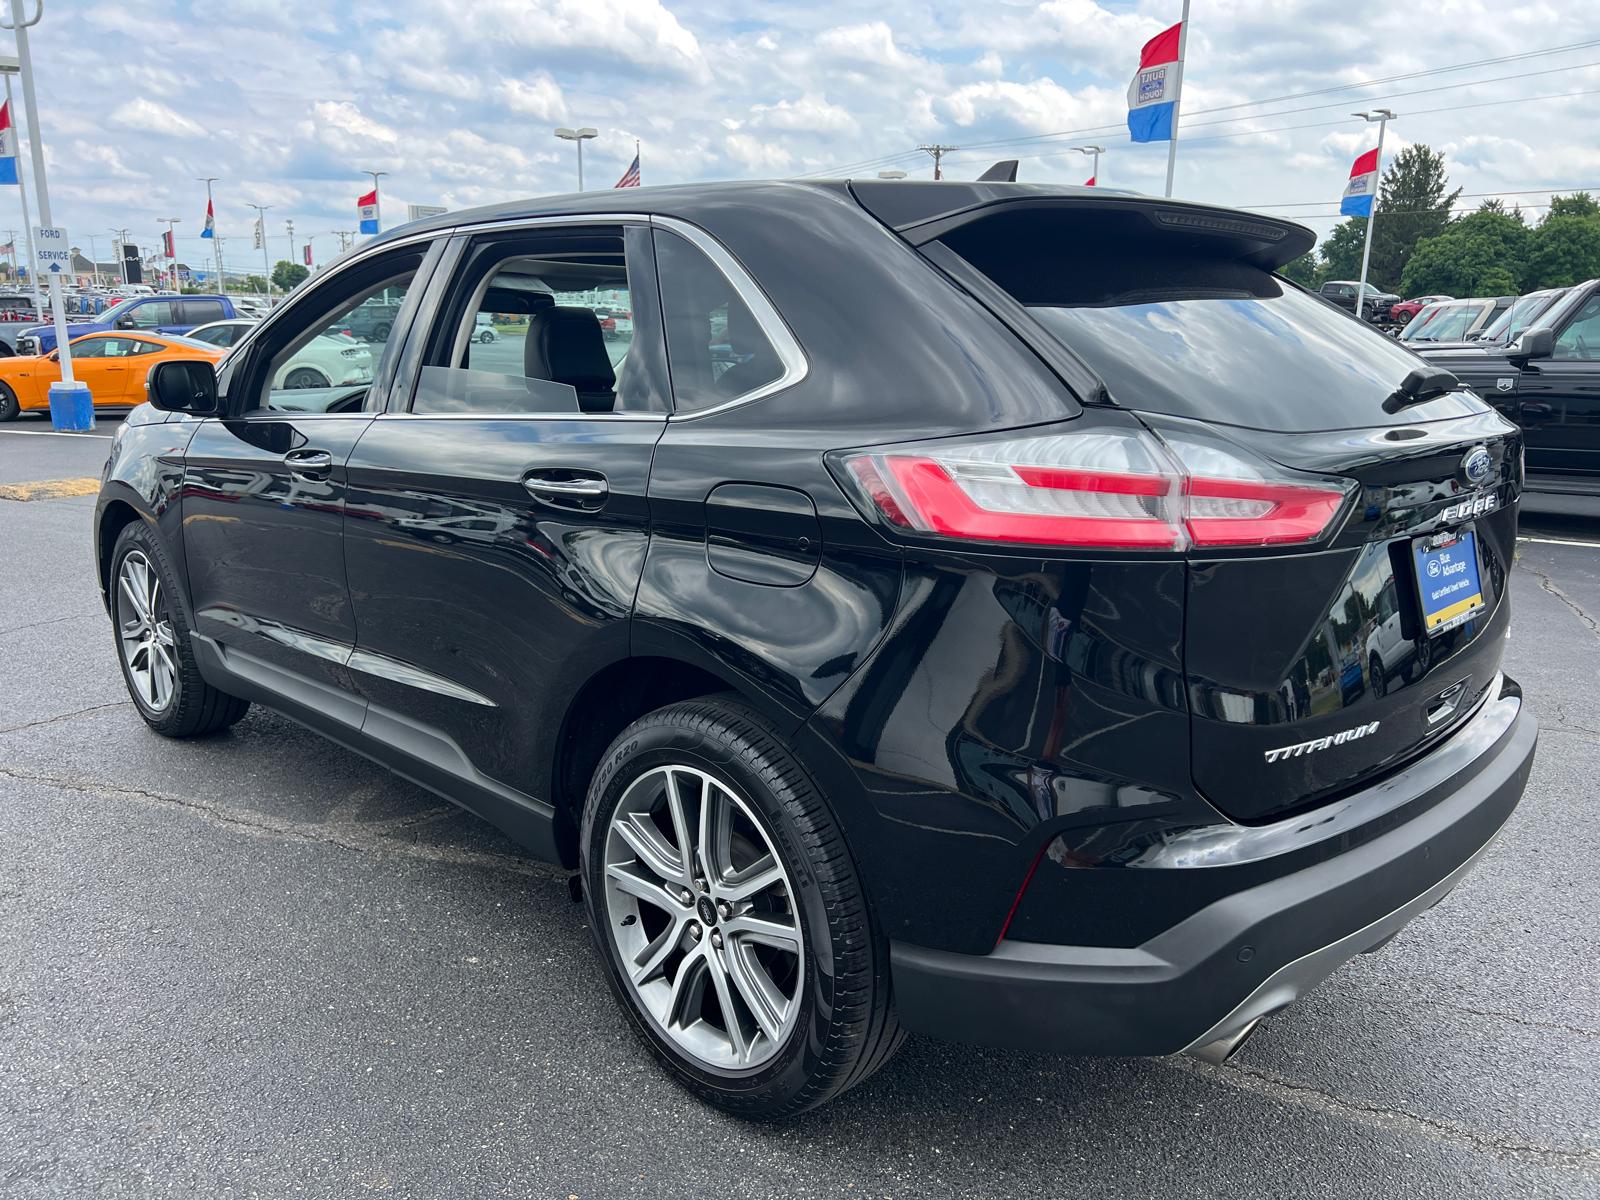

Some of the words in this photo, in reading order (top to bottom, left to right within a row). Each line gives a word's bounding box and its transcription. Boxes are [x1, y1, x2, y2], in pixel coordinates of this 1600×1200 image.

[40, 229, 60, 239] FORD
[38, 250, 69, 260] SERVICE
[1441, 494, 1496, 521] EDGE
[1439, 553, 1451, 564] Blue
[1442, 560, 1466, 577] Advantage
[1264, 720, 1380, 763] TITANIUM
[615, 740, 639, 765] R20
